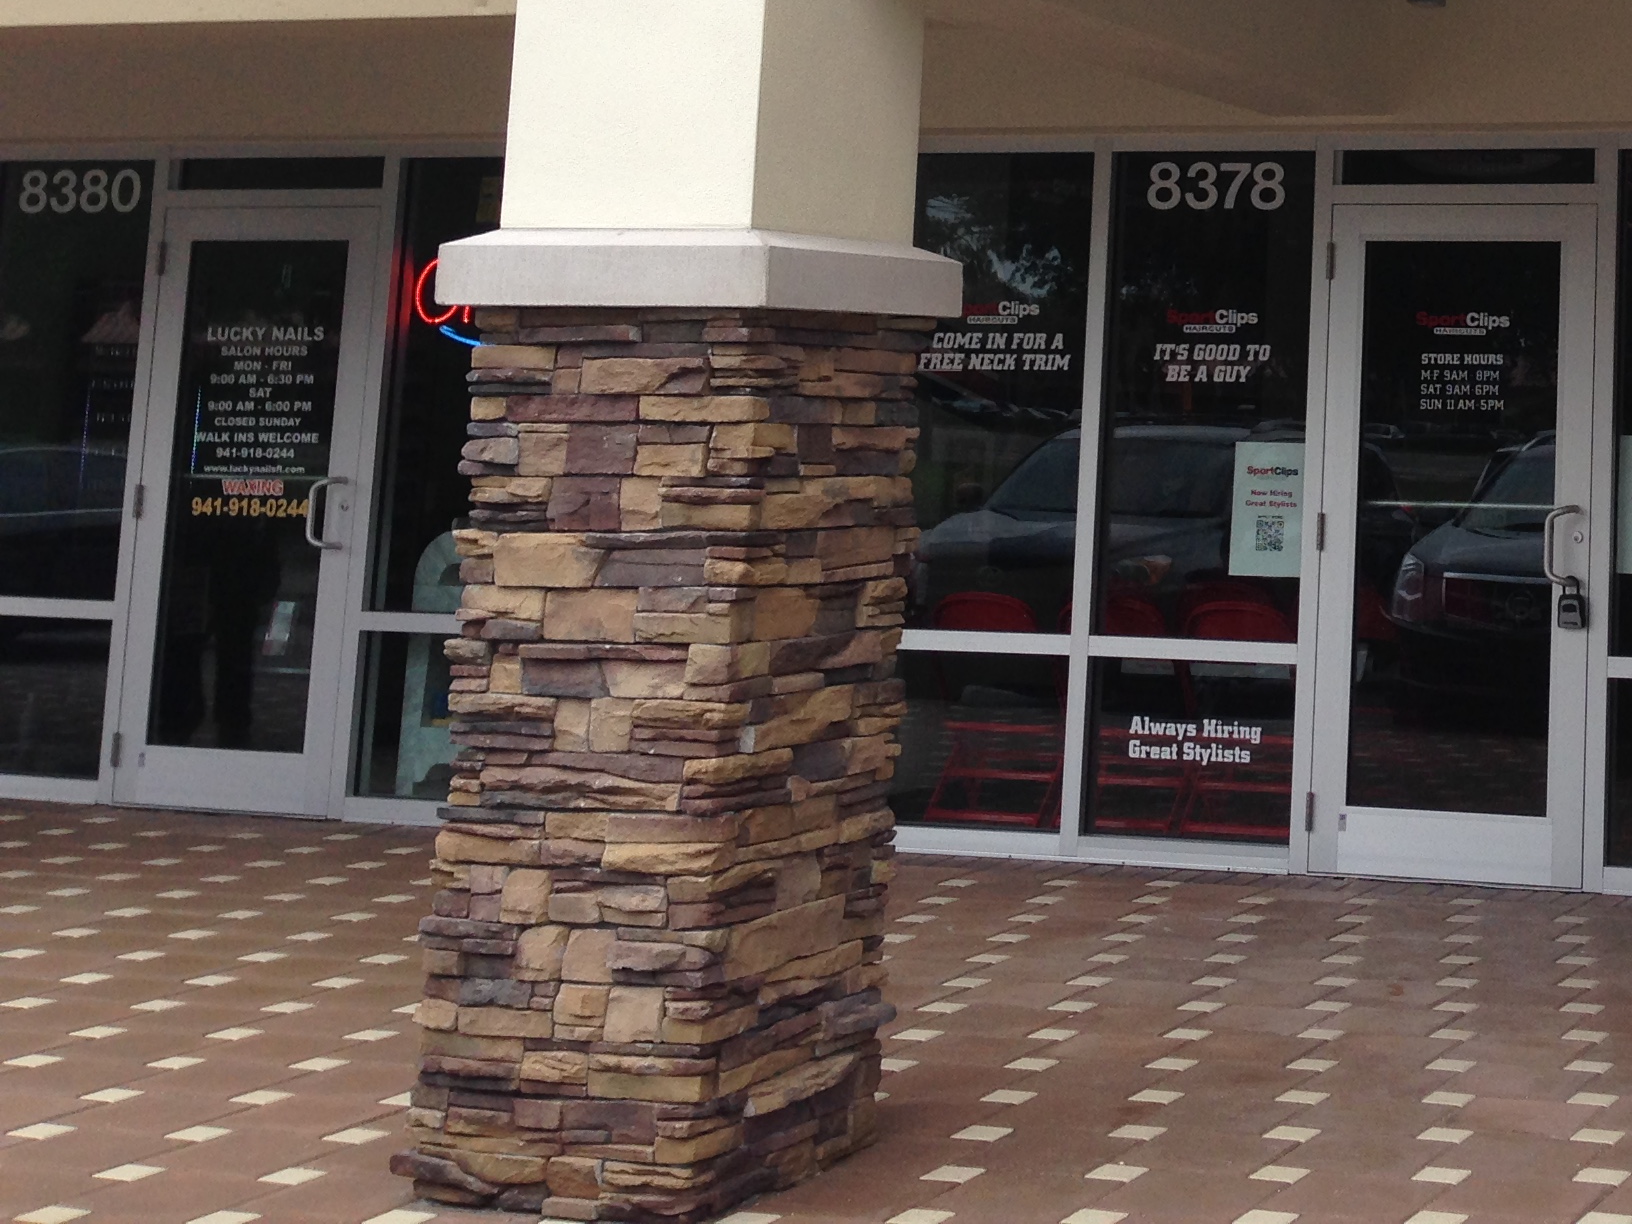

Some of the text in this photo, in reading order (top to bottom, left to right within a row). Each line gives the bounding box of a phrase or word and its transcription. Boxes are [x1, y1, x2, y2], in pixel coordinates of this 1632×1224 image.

[18, 168, 142, 214] 8380
[1146, 161, 1286, 211] 8378
[963, 300, 1040, 318] portClips
[1166, 308, 1259, 327] SportClips
[1415, 311, 1511, 330] SportClips
[207, 326, 325, 342] LUCKY NAILS
[1184, 325, 1235, 333] HAIRCUTS
[932, 332, 1064, 349] COME IN FOR A
[220, 345, 308, 356] SALON HOURS
[1153, 343, 1271, 361] IT'S GOOD TO
[233, 360, 262, 371] MON
[272, 360, 292, 371] FRI
[918, 353, 1071, 371] FREE NECK TRIM
[1421, 353, 1504, 365] STORE HOURS
[209, 374, 235, 385] 9:00
[238, 374, 257, 384] AM
[267, 374, 293, 385] 6:30
[296, 374, 314, 384] PM
[1165, 365, 1252, 382] BE A GUY
[1443, 370, 1468, 381] 9AM
[1476, 370, 1500, 381] 8PM
[248, 387, 273, 398] SAT
[1420, 384, 1442, 395] SAT
[207, 401, 233, 411] 9:00
[235, 401, 255, 411] AM
[264, 401, 290, 412] 6:00
[293, 401, 312, 411] PM
[1420, 398, 1442, 410] SUN
[214, 417, 302, 427] CLOSED SUNDAY
[195, 432, 320, 444] WALK INS WELCOME
[215, 447, 295, 459] 941-918-0244
[1246, 465, 1299, 478] SportClips
[221, 478, 285, 496] WAXING
[191, 496, 310, 517] 941-918-0244
[1129, 715, 1262, 744] Always Hiring
[1128, 739, 1251, 766] Great Stylists
